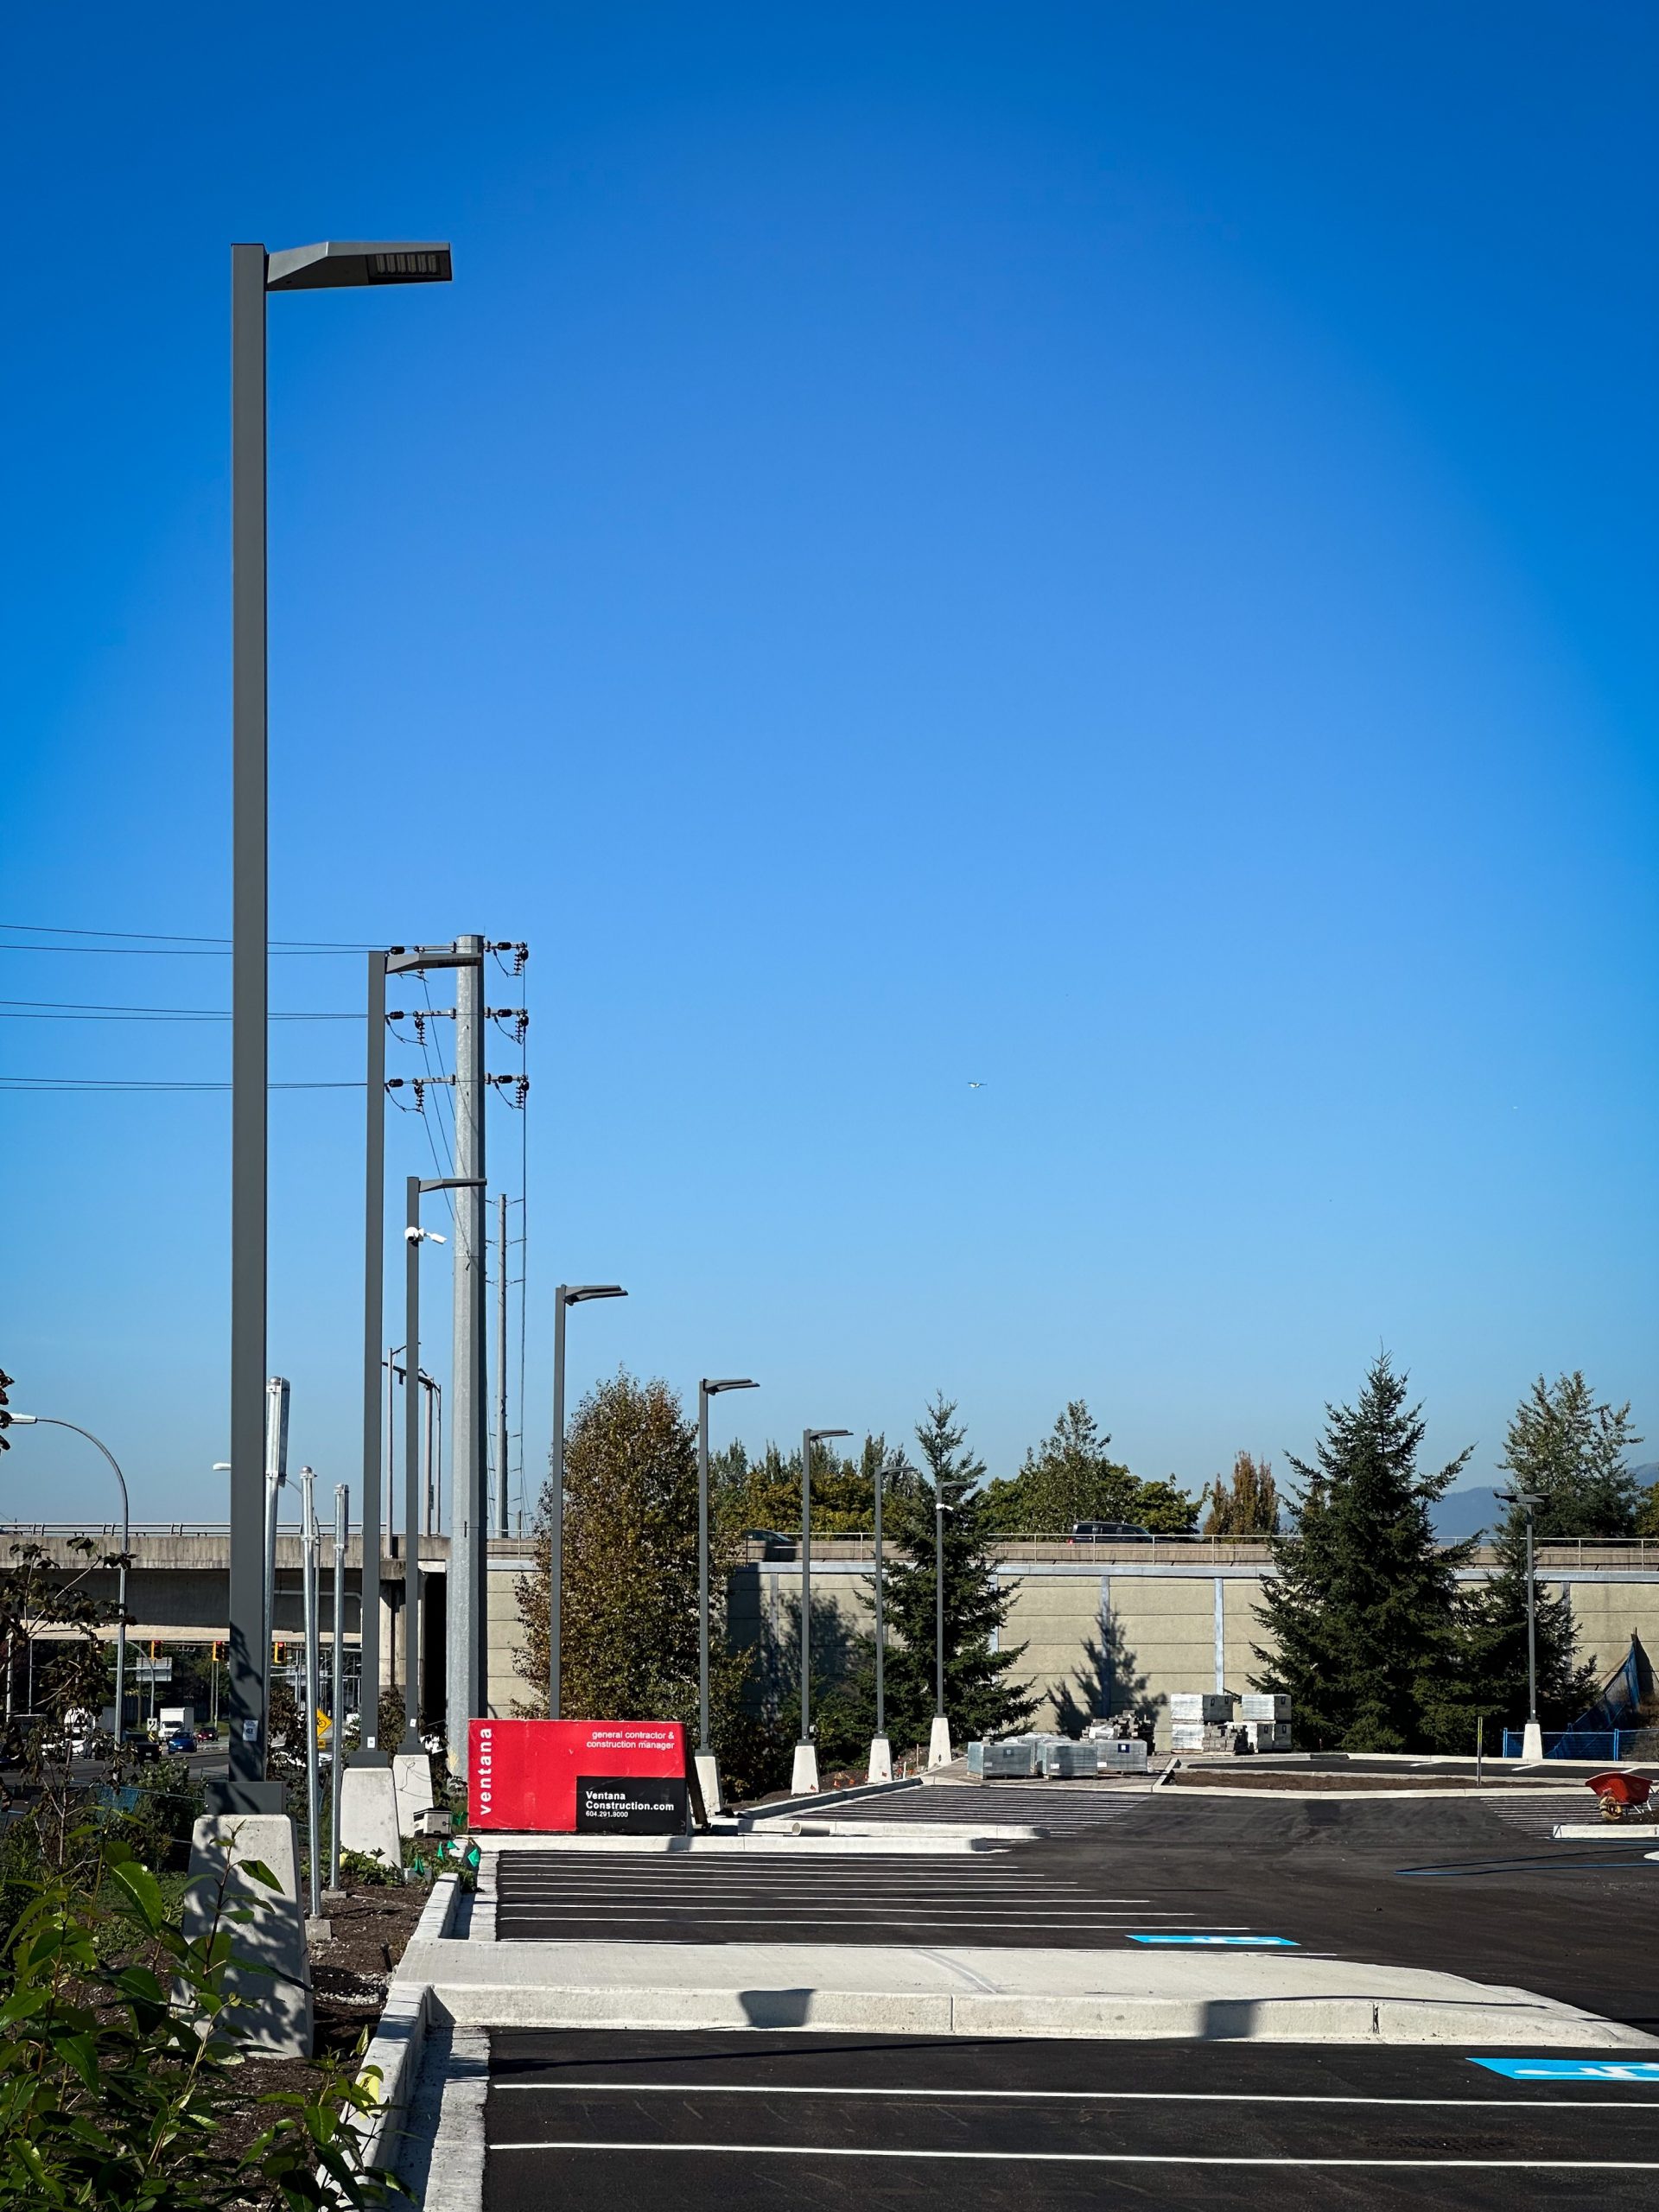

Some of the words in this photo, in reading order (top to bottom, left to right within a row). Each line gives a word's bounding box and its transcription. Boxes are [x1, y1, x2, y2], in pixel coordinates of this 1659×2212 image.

[592, 1731, 622, 1740] general
[587, 1740, 636, 1749] construction
[639, 1741, 675, 1751] manager
[478, 1728, 492, 1815] ventana
[586, 1791, 626, 1800] Ventana
[586, 1801, 674, 1811] Construction.com
